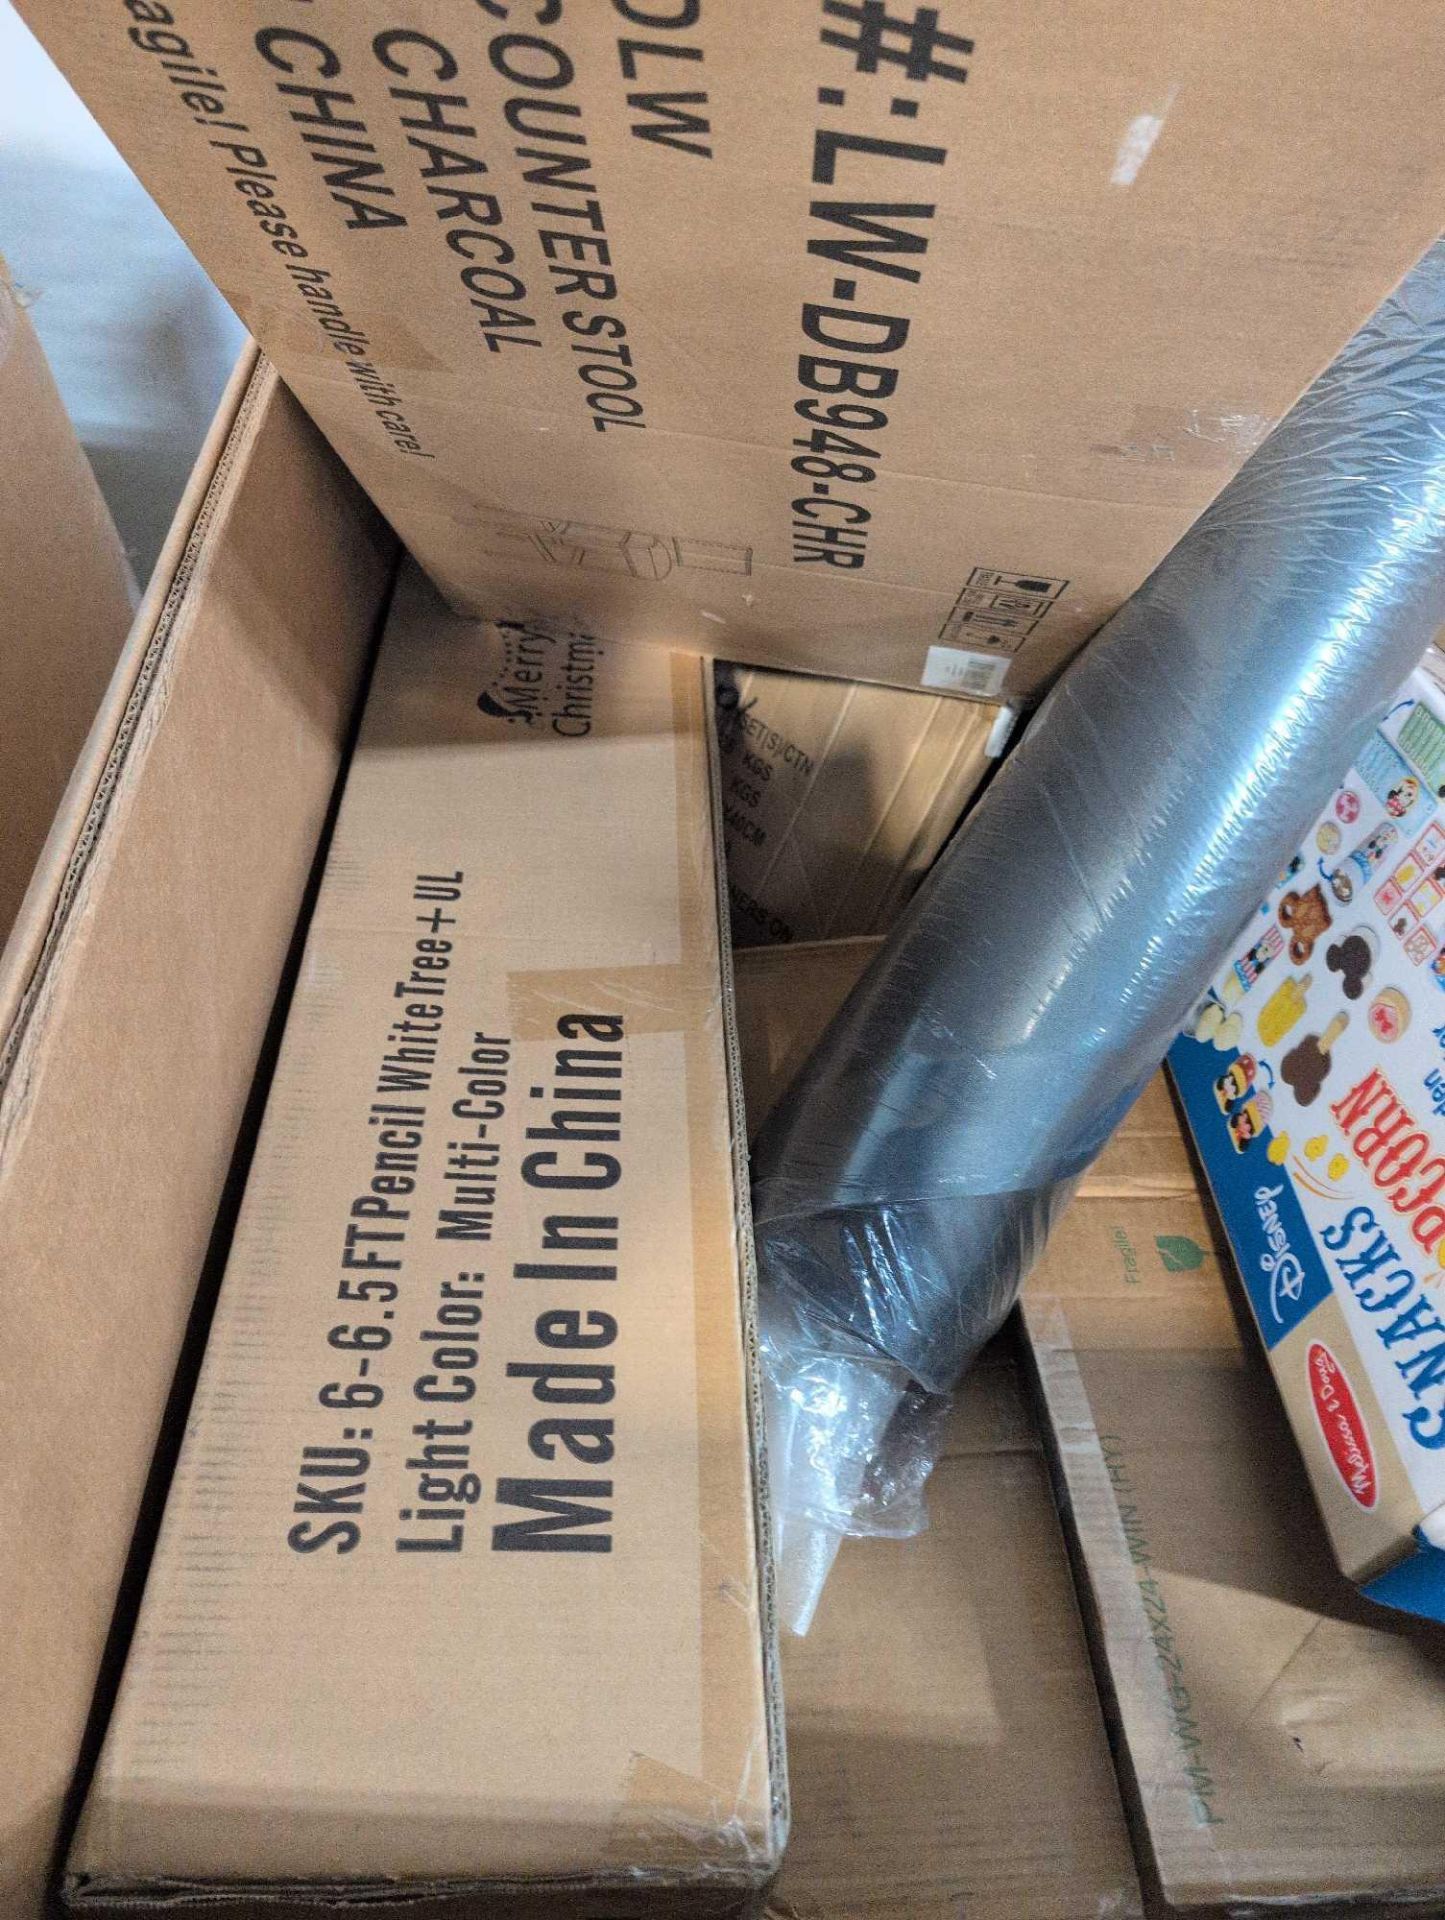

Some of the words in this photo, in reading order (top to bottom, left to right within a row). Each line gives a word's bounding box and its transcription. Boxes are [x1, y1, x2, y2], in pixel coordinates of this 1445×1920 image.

[254, 26, 409, 231] CHINA
[371, 28, 544, 354] CHARCOAL
[208, 139, 310, 259] Please
[284, 263, 371, 357] handle
[344, 358, 403, 409] with
[374, 409, 437, 460] care!
[560, 309, 648, 434] STOOL
[502, 630, 557, 711] Merry
[434, 1030, 512, 1242] Multi-Color
[519, 1012, 626, 1191] China
[511, 1214, 620, 1282] In
[1254, 1184, 1306, 1325] Disney
[412, 1270, 486, 1404] Color:
[394, 1418, 483, 1554] Light
[490, 1308, 619, 1555] Made
